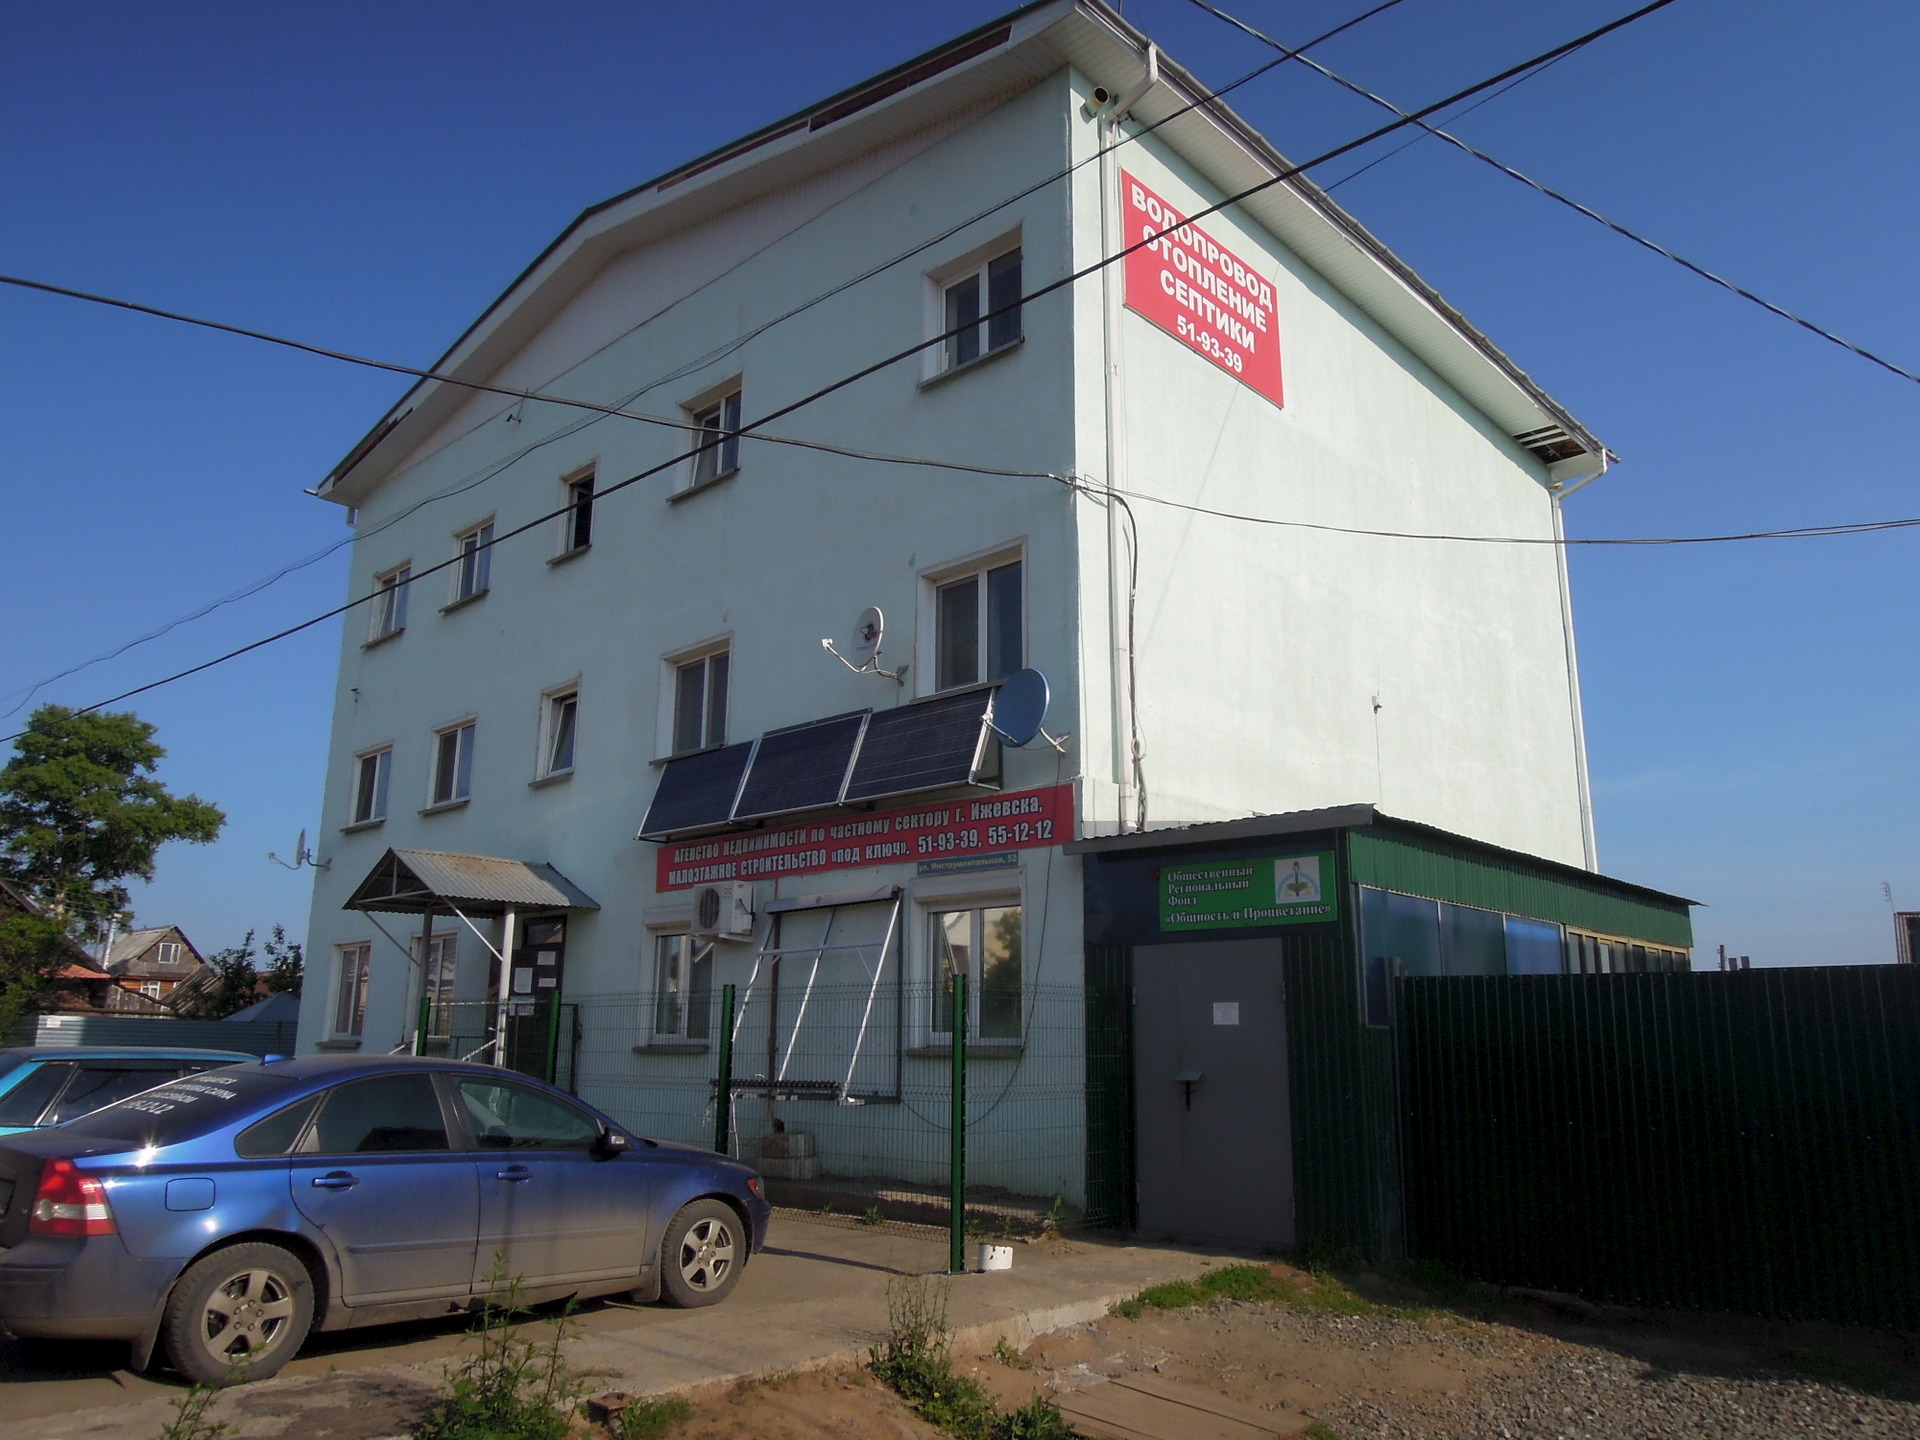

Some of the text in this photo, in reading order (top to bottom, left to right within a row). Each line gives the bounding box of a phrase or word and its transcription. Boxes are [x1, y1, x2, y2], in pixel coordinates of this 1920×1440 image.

[1131, 183, 1273, 313] ВОДОПРОВОД
[1142, 225, 1267, 333] ОТОПЛЕНИЕ
[1160, 269, 1256, 353] СЕПТИКИ
[1177, 314, 1243, 373] 51-93-39
[668, 862, 737, 886] МАЛОЭТАЖНОЕ
[740, 849, 826, 876] СТРОИТЕЛЬСТВО
[918, 829, 982, 854] 51-93-39,
[988, 819, 1053, 845] 55-12-12
[674, 796, 1043, 864] АГЕНСТВО НЕДВИЖИМОСТИ по частному сектору г. Ижевска,
[919, 854, 1018, 873] ул. Инструментальная, 52
[1167, 864, 1253, 882] Общественный
[1168, 878, 1250, 894] Региональный
[1165, 904, 1332, 924] «Общность и Процветание»
[1168, 896, 1197, 907] Фонд
